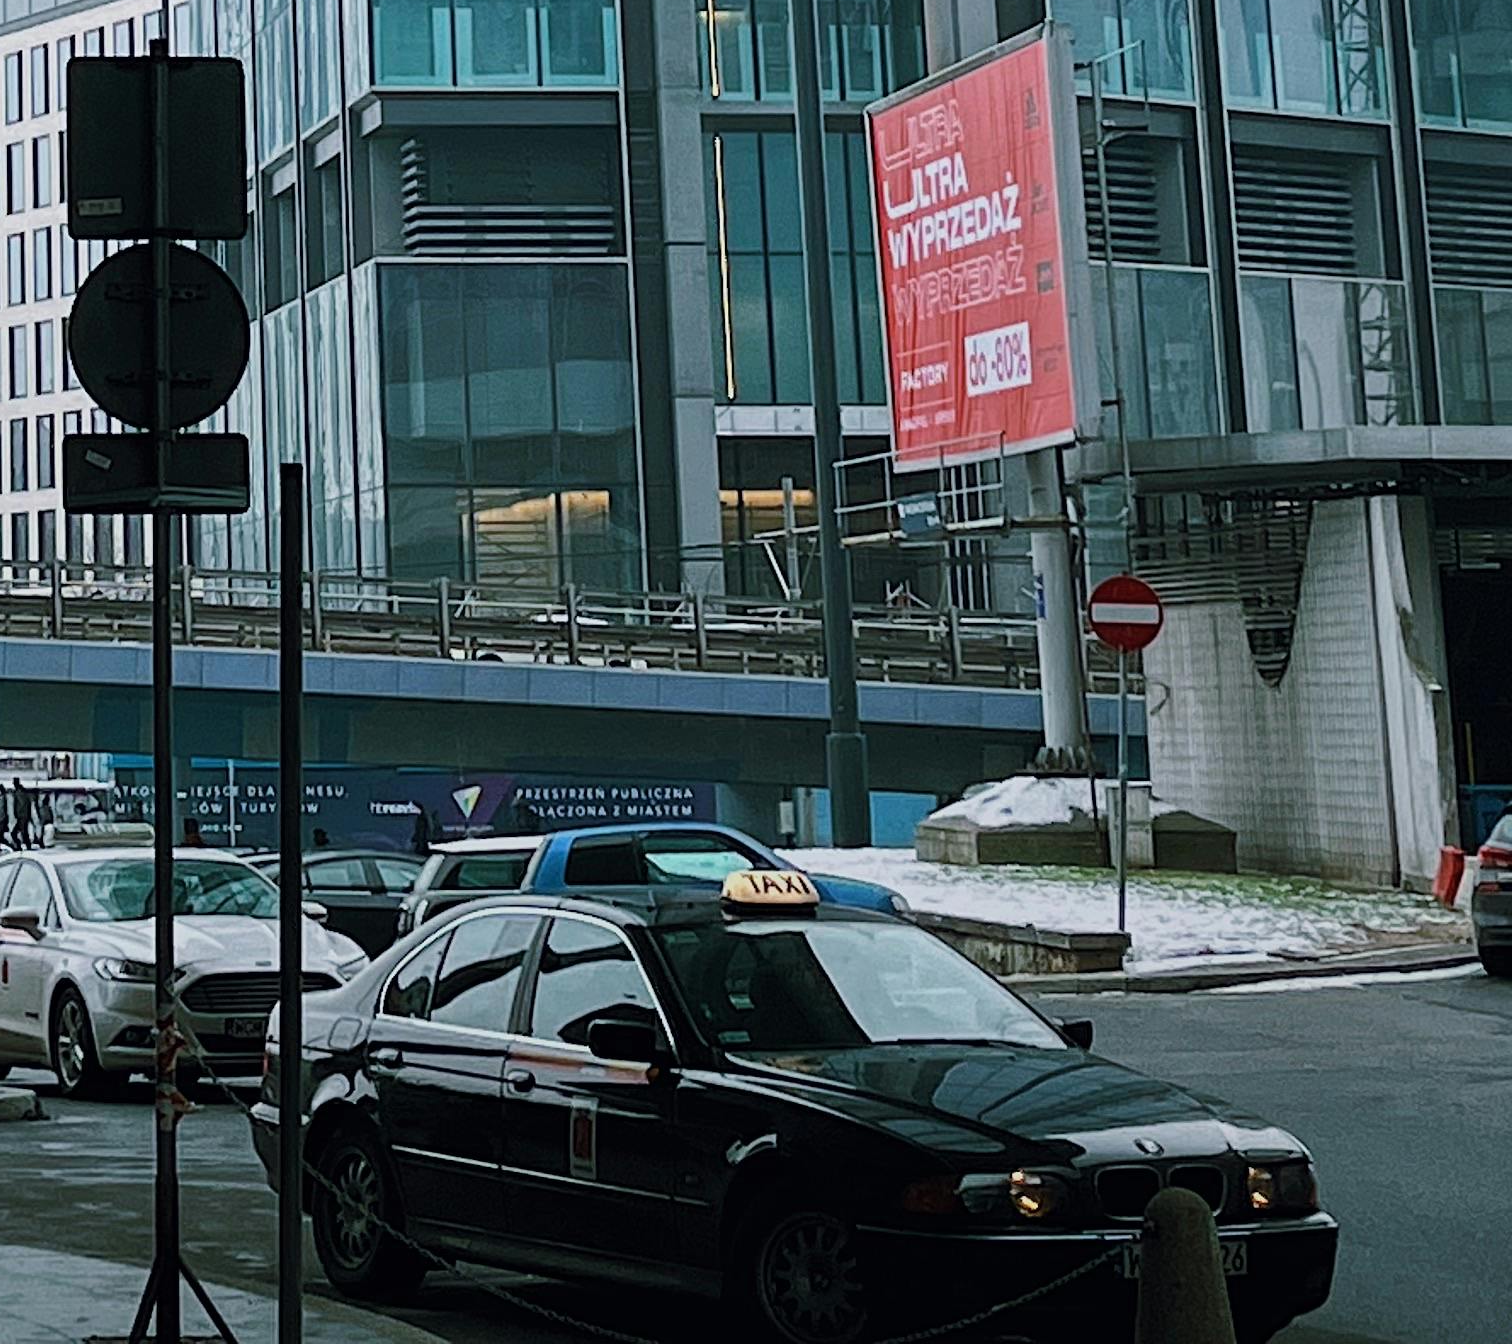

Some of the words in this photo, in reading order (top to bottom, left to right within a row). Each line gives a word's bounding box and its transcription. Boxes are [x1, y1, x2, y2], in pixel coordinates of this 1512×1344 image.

[879, 99, 965, 171] ULTRA
[883, 152, 969, 219] ULTRA
[888, 171, 1022, 270] WYPRZEDAŻ
[891, 232, 1027, 327] WYPRZEDAŻ
[900, 361, 949, 393] FACTORY
[970, 339, 988, 386] do
[247, 785, 276, 798] DLA
[515, 785, 605, 801] PRZESTRZEŃ
[611, 786, 694, 801] PUBLICZNA
[612, 805, 620, 817] Z
[627, 805, 694, 817] MIASTEM
[742, 873, 810, 894] TAXI
